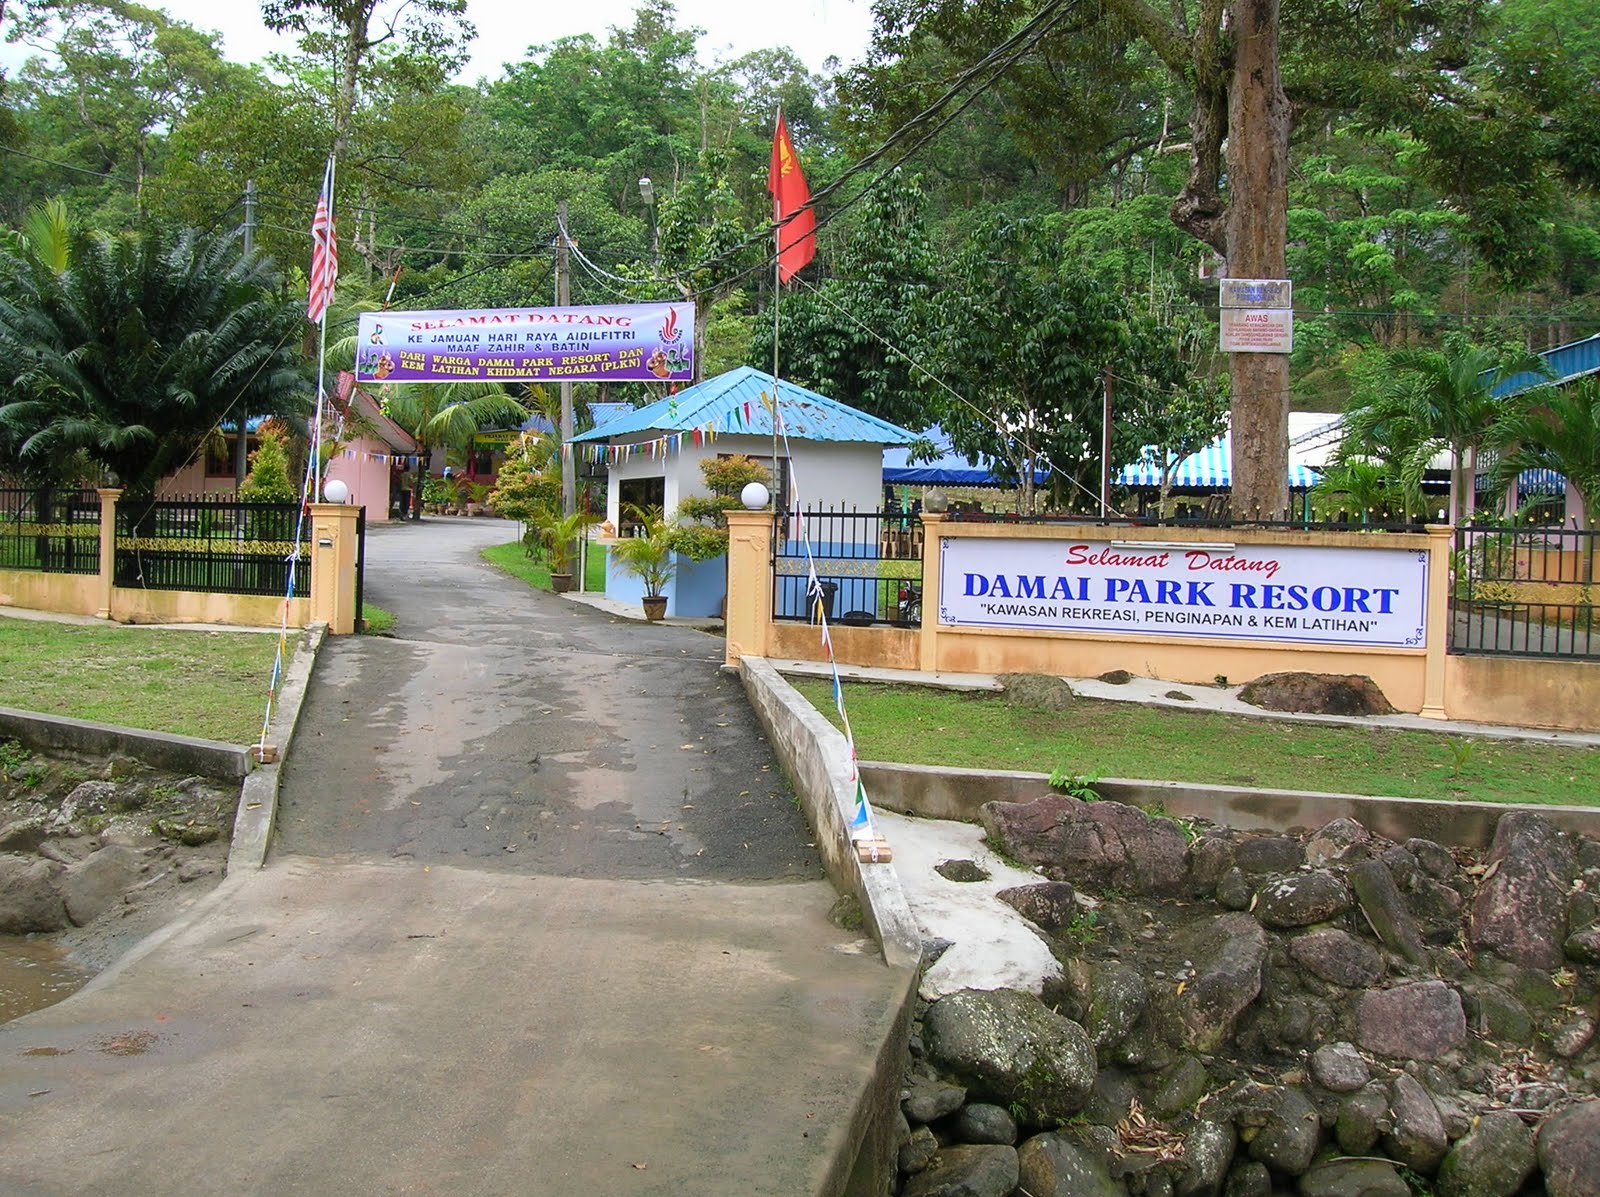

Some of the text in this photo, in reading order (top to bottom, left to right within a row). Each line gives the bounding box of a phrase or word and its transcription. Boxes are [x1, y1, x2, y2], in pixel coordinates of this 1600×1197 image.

[411, 314, 632, 331] SELAMAT DATANG
[1245, 314, 1269, 323] AWAS
[408, 330, 635, 344] KE JAMUAN HARI RAYA AIDILFITRI
[400, 347, 644, 367] DARI WARGA DAMAI PARK RESORT DAN
[447, 342, 590, 353] MAAF ZAHIR & BATIN
[401, 357, 641, 377] KEM LATIHAN KHIDMAT NEGARA (PLKN)
[1065, 544, 1281, 579] Selamat Datang
[963, 573, 1399, 614] DAMAI PARK RESORT
[980, 603, 1378, 632] "KAWASAN REKREASI, PENGINAPAN & KEM LATIHAN"
